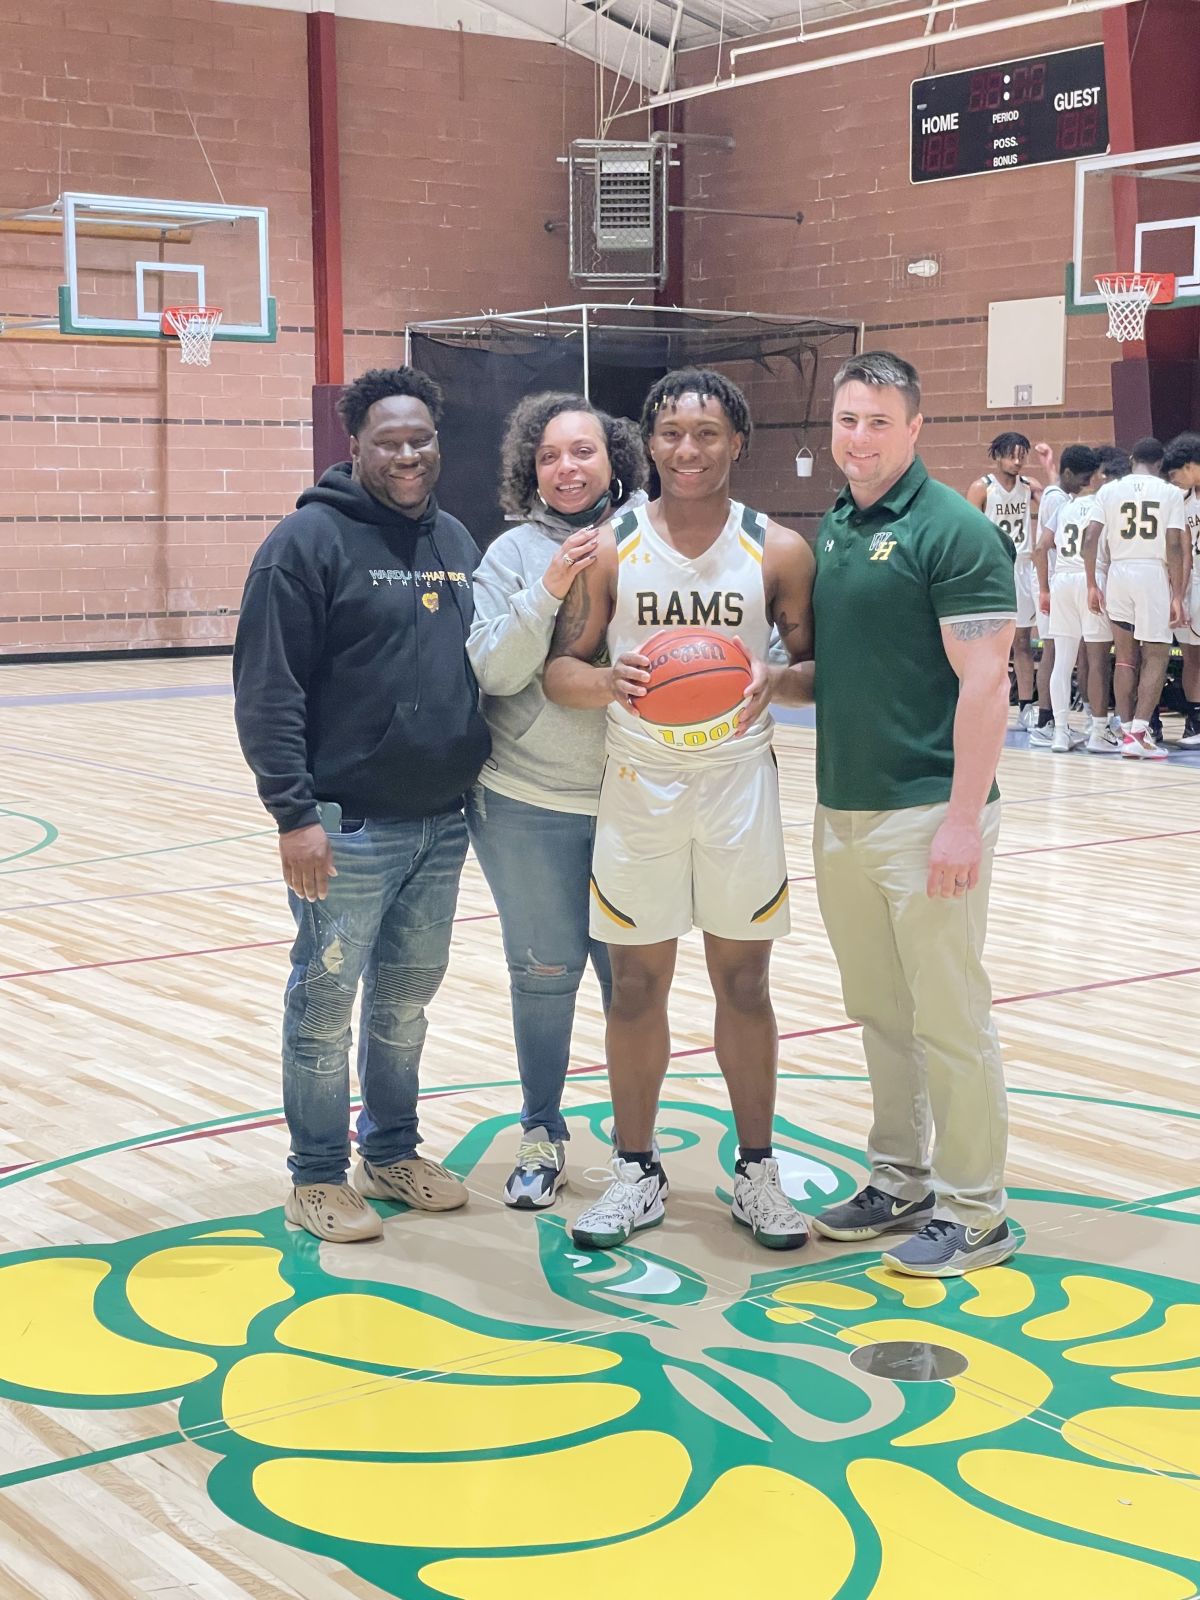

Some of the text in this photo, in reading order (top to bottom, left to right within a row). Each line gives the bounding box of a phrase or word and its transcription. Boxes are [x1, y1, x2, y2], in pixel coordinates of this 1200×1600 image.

[1053, 87, 1101, 112] GUEST
[921, 112, 959, 135] HOME
[992, 110, 1020, 124] PERIOD
[993, 136, 1019, 149] POSS.
[993, 154, 1018, 167] BONUS
[995, 502, 1027, 515] RAMS
[1120, 501, 1160, 540] 35
[636, 591, 744, 627] RAMS
